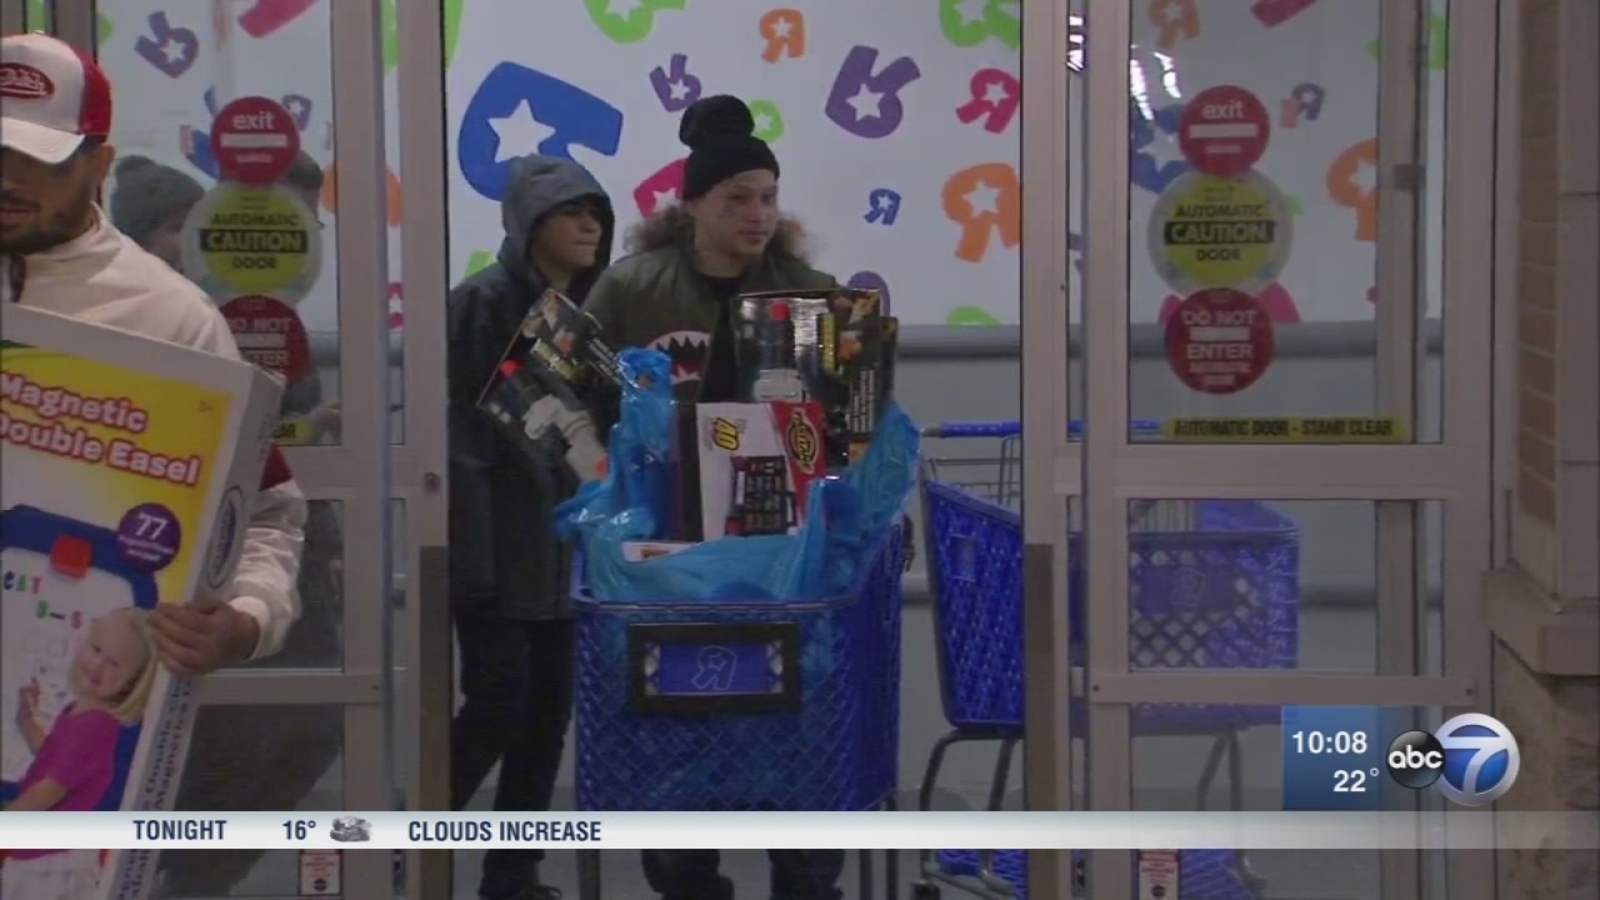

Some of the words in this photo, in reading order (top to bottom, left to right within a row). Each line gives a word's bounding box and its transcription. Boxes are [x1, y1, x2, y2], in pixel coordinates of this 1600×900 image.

[1202, 98, 1245, 119] exit
[233, 111, 275, 130] exit
[211, 213, 299, 226] AUTOMATIC
[1175, 204, 1263, 218] AUTOMATIC
[206, 232, 300, 250] CAUTION
[1171, 223, 1267, 242] CAUTION
[232, 256, 277, 270] DOOR
[1196, 249, 1241, 261] DOOR
[1182, 310, 1211, 326] DO
[1215, 310, 1256, 326] NOT
[1186, 343, 1254, 360] ENTER
[0, 372, 148, 433] Magnetic
[1174, 419, 1248, 437] AUTOMATIC
[1252, 419, 1289, 437] DOOR
[1302, 419, 1345, 437] STAND
[1350, 419, 1393, 437] CLEAR
[108, 439, 202, 487] Easel
[136, 512, 168, 540] 77
